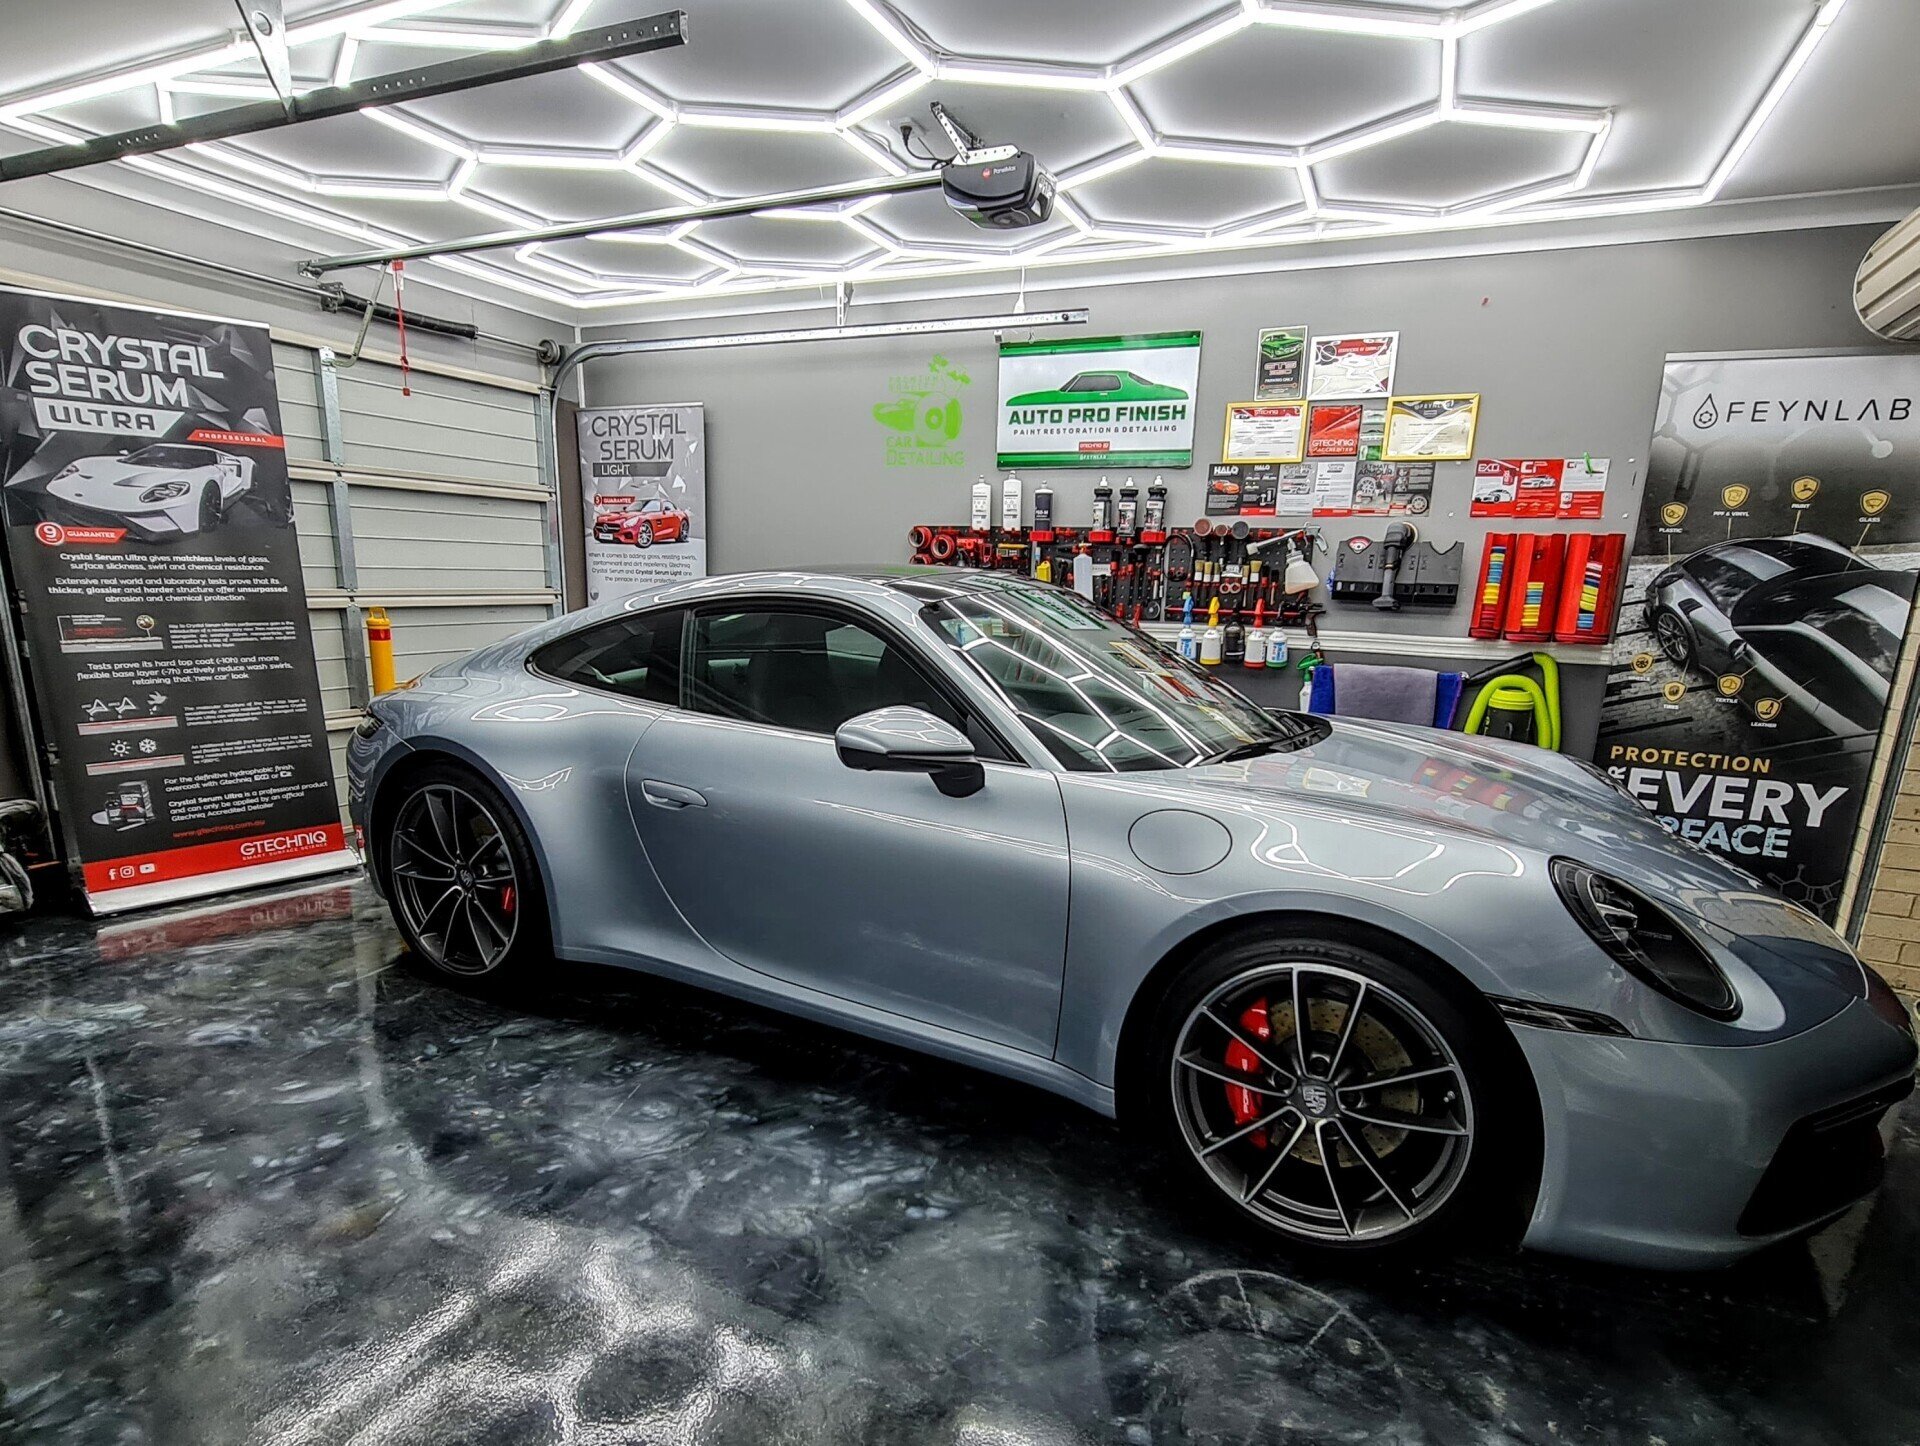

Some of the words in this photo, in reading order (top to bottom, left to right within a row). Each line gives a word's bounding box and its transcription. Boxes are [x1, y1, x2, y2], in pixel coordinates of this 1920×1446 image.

[18, 323, 225, 379] CRYSTAL
[24, 361, 189, 408] SERUM
[48, 404, 156, 431] ULTRA
[1008, 408, 1063, 425] AUTO
[1068, 407, 1111, 424] PRO
[1116, 404, 1187, 422] FINISH
[1726, 398, 1912, 423] FEYNLAB
[591, 413, 687, 437] CRYSTAL
[1013, 428, 1042, 436] PAINT
[1043, 427, 1112, 435] RESTORATION
[1122, 425, 1178, 433] DETAILING
[198, 432, 267, 443] PROFESSIONAL
[1312, 439, 1354, 447] GTECHNIQ
[600, 438, 674, 461] SERUM
[886, 450, 965, 467] DETAILING
[601, 464, 631, 475] LIGHT
[1214, 465, 1240, 476] HALO
[66, 529, 117, 539] GUARANTEE
[60, 553, 93, 561] Crystal
[95, 553, 124, 561] Serum
[149, 555, 171, 563] gives
[70, 562, 104, 571] surface
[48, 586, 84, 594] thicker,
[86, 587, 122, 595] glossier
[216, 586, 235, 594] offer
[238, 586, 288, 594] unsurpassed
[164, 578, 206, 586] laboratory
[204, 594, 245, 602] protection
[77, 671, 110, 681] flexible
[136, 669, 158, 678] layer
[183, 666, 215, 674] actively
[217, 664, 245, 672] reduce
[87, 662, 112, 670] Tests
[114, 662, 140, 670] prove
[178, 659, 193, 667] top
[132, 676, 171, 686] retaining
[231, 672, 250, 680] look
[1610, 745, 1772, 773] PROTECTION
[164, 778, 178, 786] For
[194, 772, 228, 782] definitive
[230, 767, 273, 778] hydrophobic
[165, 783, 201, 792] overcoat
[201, 780, 219, 788] with
[219, 777, 252, 786] Gtechniq
[168, 798, 196, 808] Crystal
[197, 795, 223, 804] Serum
[224, 792, 243, 800] Ultra
[258, 785, 300, 796] professional
[301, 781, 328, 791] product
[1627, 766, 1849, 828] EVERY
[169, 807, 186, 815] and
[203, 802, 219, 811] only
[221, 800, 231, 808] be
[232, 797, 259, 807] applied
[260, 796, 270, 804] by
[171, 812, 206, 822] Gtechniq
[207, 806, 246, 817] Accredited
[247, 802, 274, 812] Detailer
[240, 831, 327, 856] GTECHNIQ
